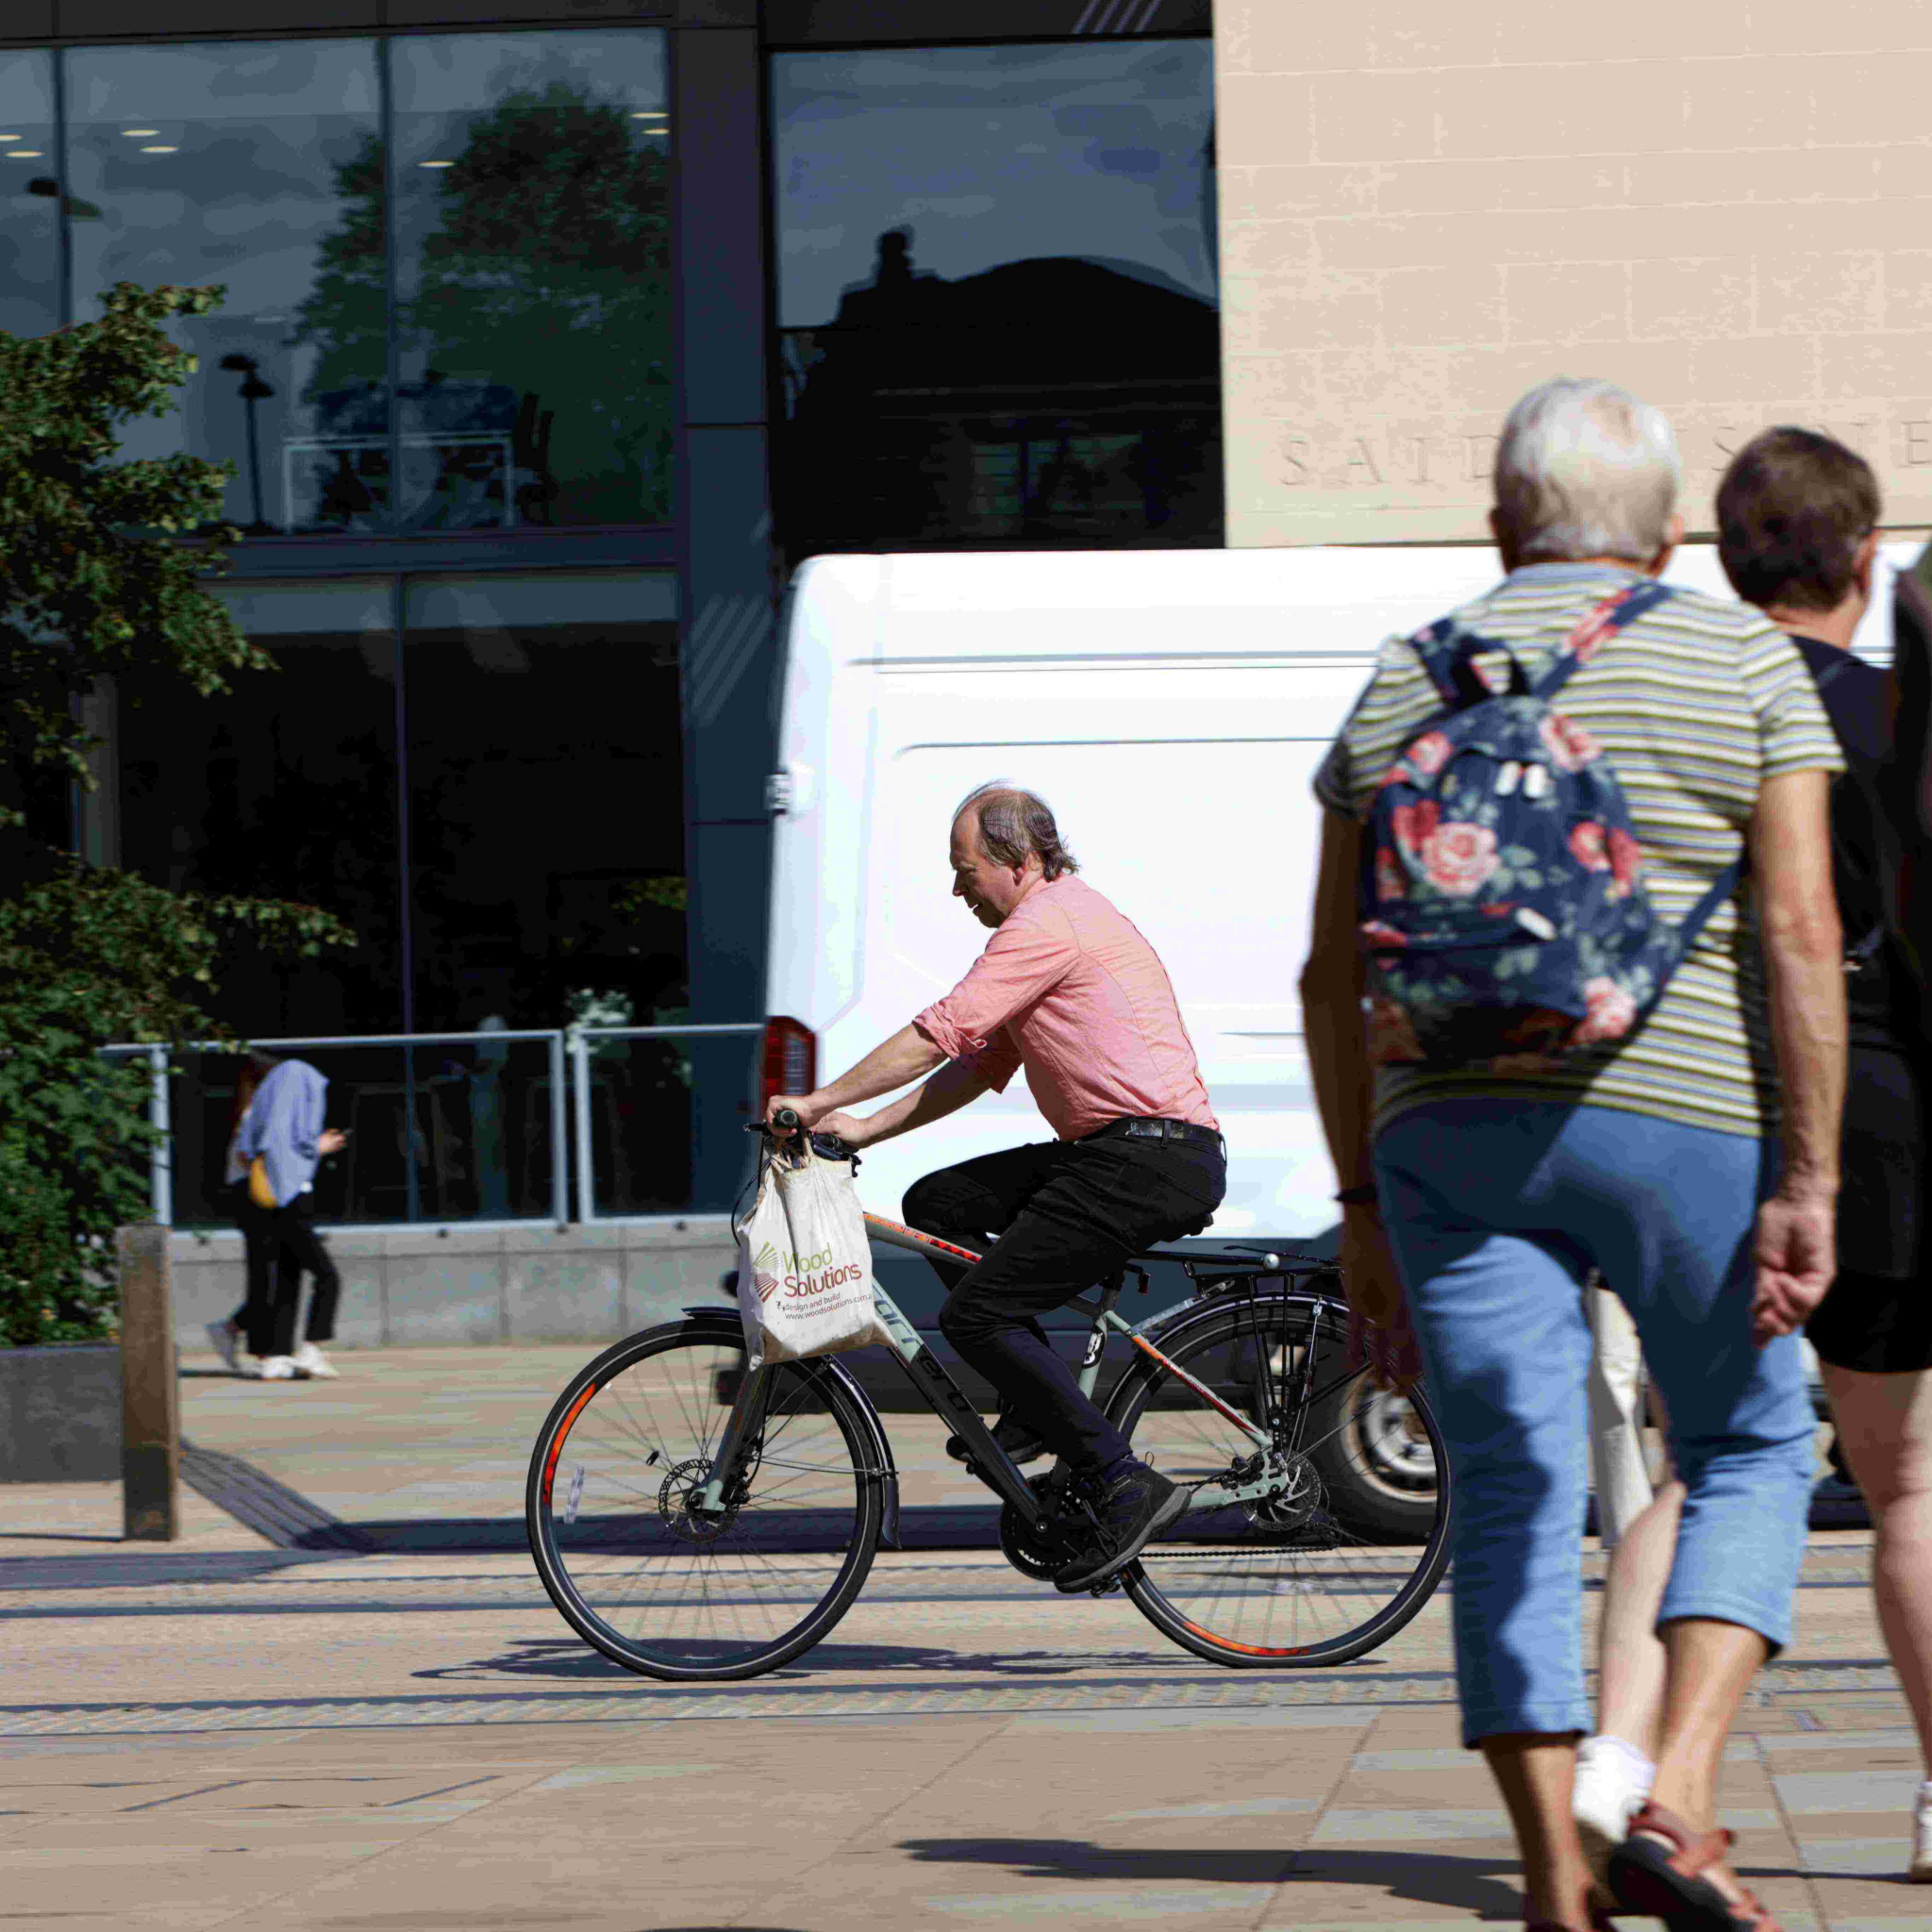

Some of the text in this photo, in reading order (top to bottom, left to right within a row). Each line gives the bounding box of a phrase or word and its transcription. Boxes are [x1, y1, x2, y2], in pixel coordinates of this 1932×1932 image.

[782, 1241, 832, 1274] Wood
[784, 1264, 862, 1297] Solutions
[785, 1291, 841, 1312] design and build
